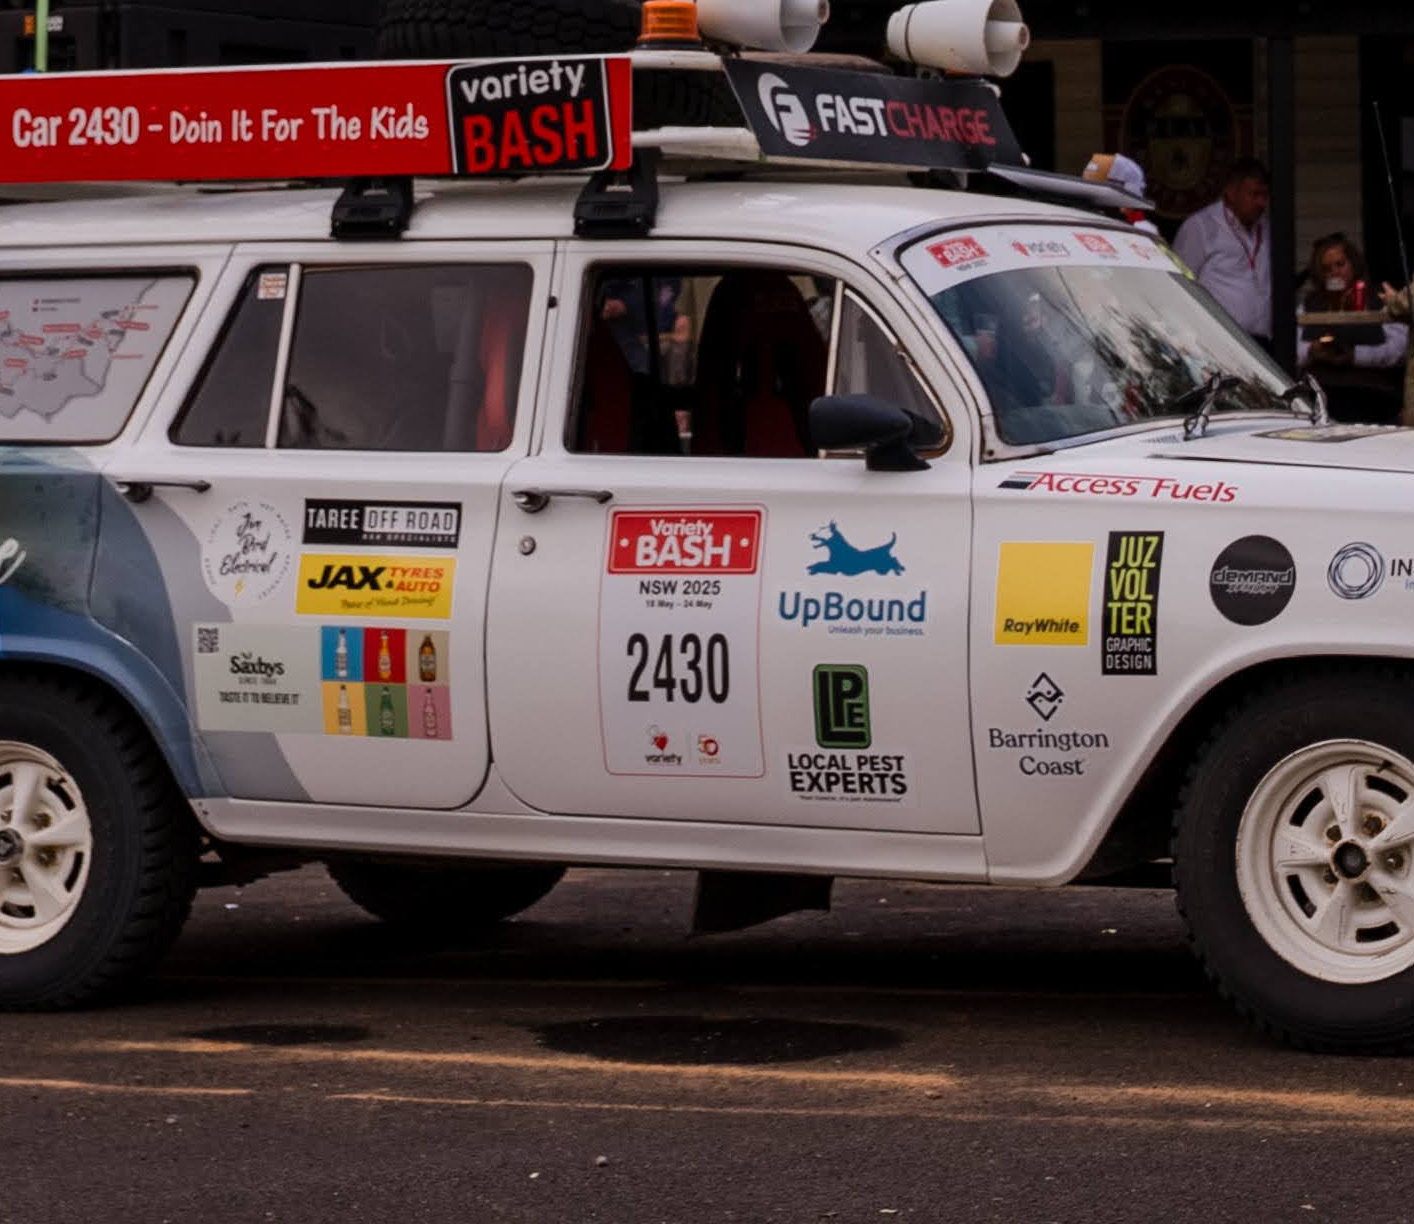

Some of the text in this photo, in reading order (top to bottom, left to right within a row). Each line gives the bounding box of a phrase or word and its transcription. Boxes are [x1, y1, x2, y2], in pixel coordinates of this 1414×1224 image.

[460, 61, 585, 104] variety
[13, 108, 62, 148] Car
[69, 106, 140, 147] 2430
[170, 110, 222, 144] Doin
[231, 109, 253, 142] It
[262, 110, 304, 142] For
[311, 105, 361, 141] The
[370, 103, 429, 140] Kids
[815, 94, 996, 146] FASTCHARGE
[463, 99, 598, 173] BASH
[1028, 473, 1239, 502] Access Fuels
[307, 507, 360, 530] TAREE
[368, 510, 399, 531] OFF
[406, 511, 454, 532] ROAD
[650, 518, 713, 538] Variety
[635, 534, 732, 567] BASH
[1112, 536, 1160, 568] JUZ
[308, 565, 387, 591] JAX
[389, 566, 444, 579] TYRES
[395, 580, 441, 593] AUTO
[639, 580, 721, 595] NSW 2025
[1110, 568, 1153, 602] VOL
[657, 600, 674, 610] May
[695, 600, 713, 610] May
[778, 590, 927, 627] UpBound
[1108, 602, 1152, 634] TER
[865, 627, 884, 637] your
[1106, 637, 1152, 653] GRAPHIC
[230, 654, 285, 678] Saxbys
[627, 633, 730, 704] 2430
[1106, 654, 1152, 669] DESIGN
[988, 728, 1109, 752] Barrington
[788, 753, 905, 771] LOCAL PEST
[1019, 755, 1085, 776] Coast
[790, 772, 908, 795] EXPERTS
